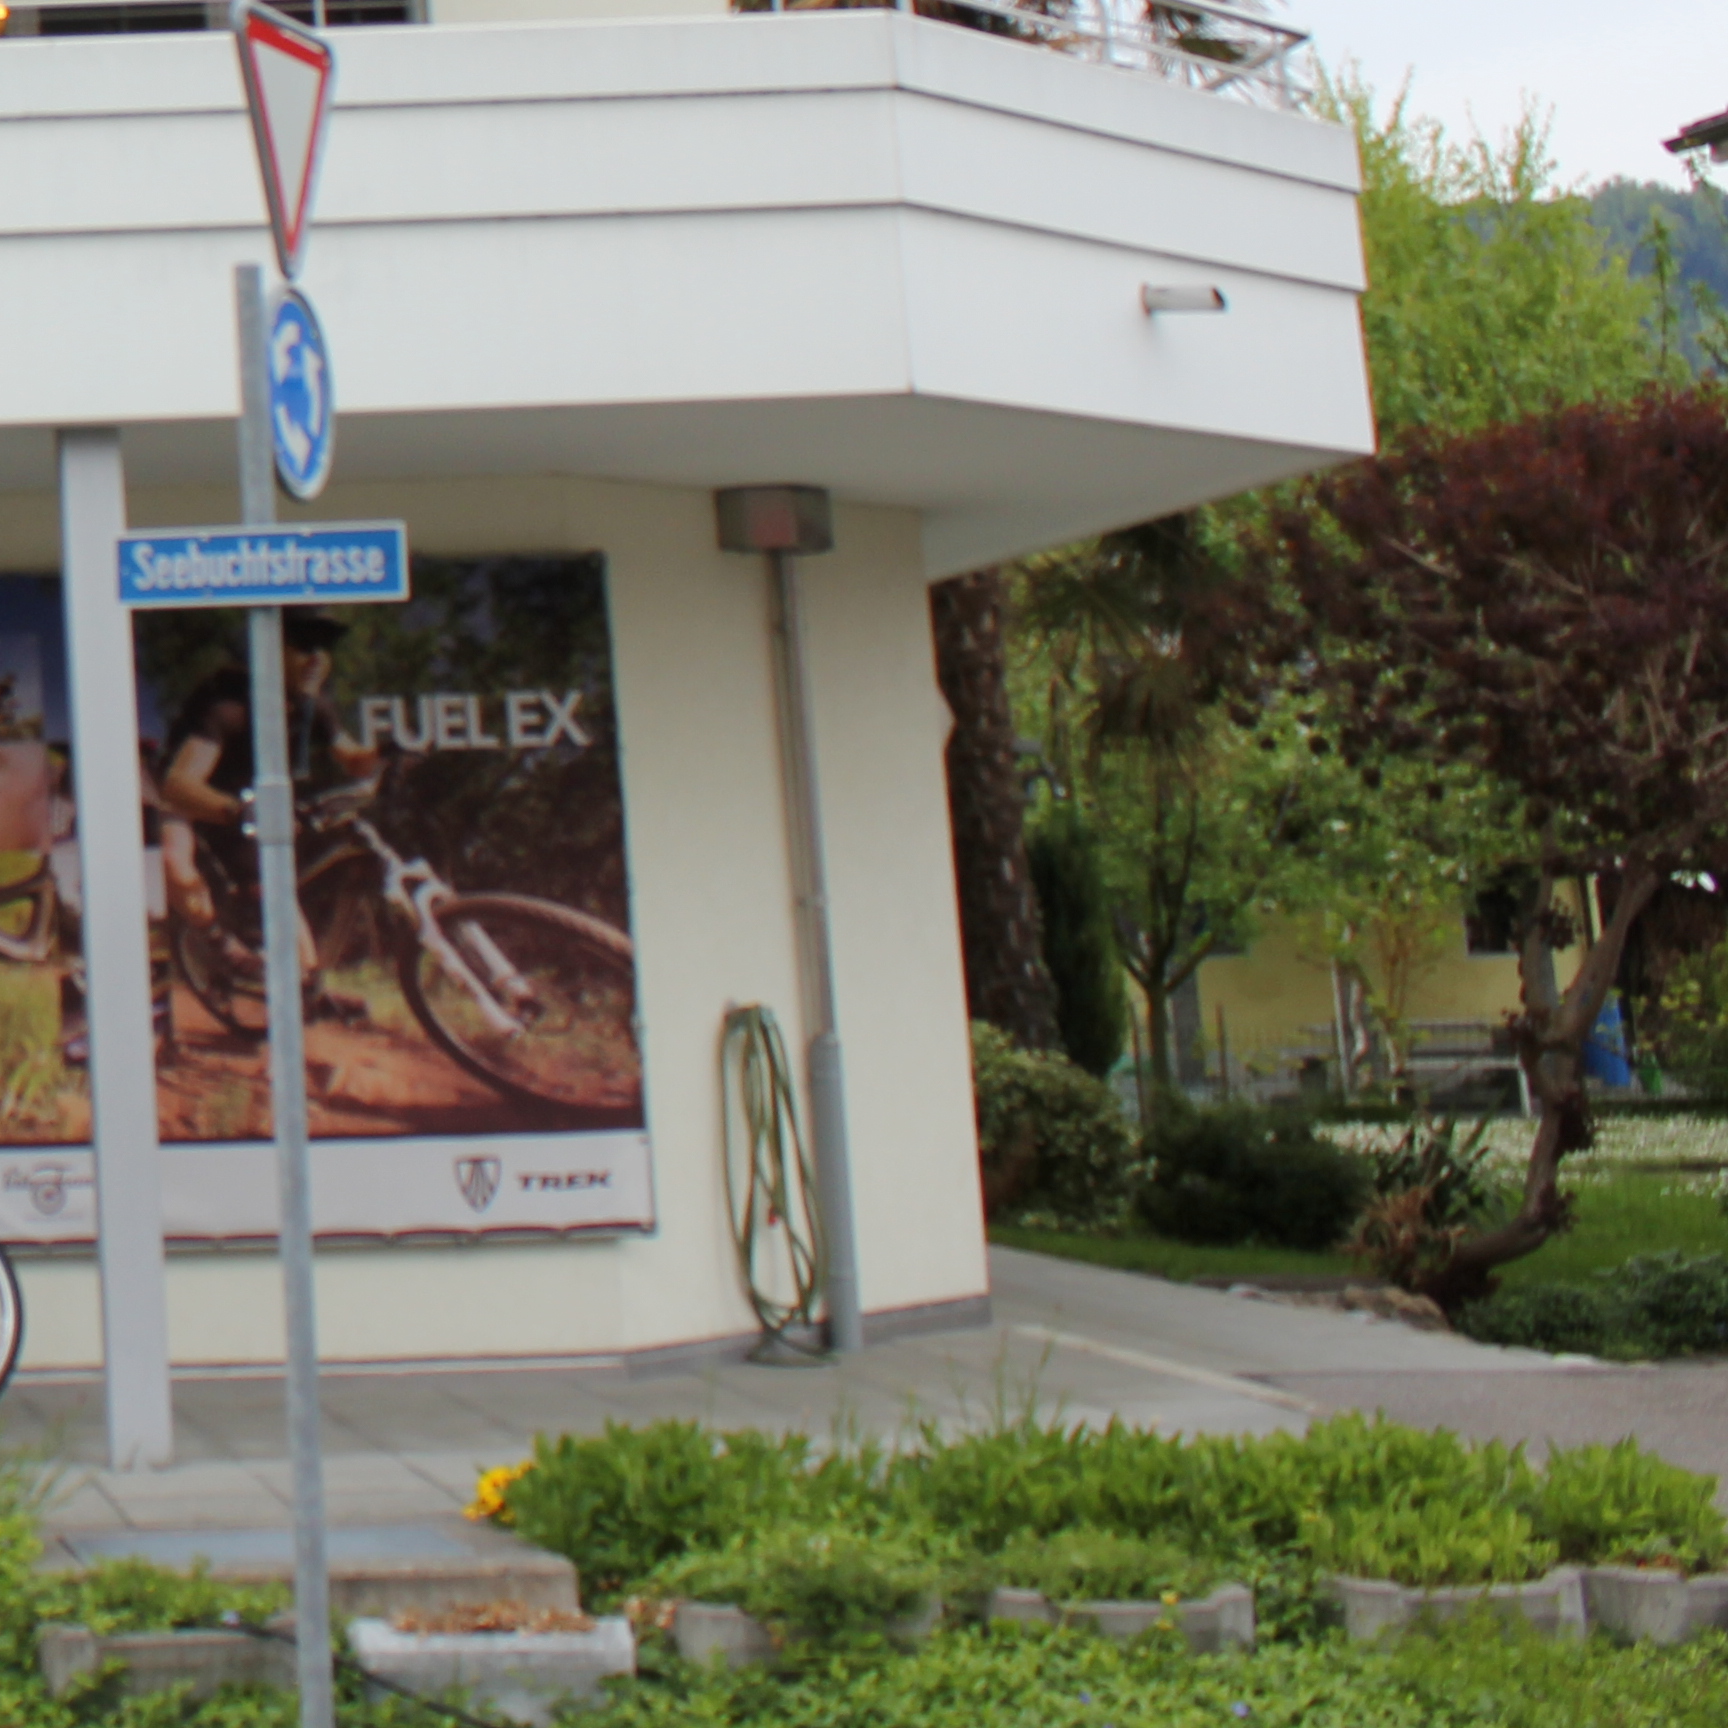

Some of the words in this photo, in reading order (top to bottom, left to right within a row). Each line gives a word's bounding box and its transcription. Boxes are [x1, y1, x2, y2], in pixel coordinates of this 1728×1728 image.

[131, 539, 386, 590] Seebuchtstrasse
[359, 691, 500, 754] FUEL
[505, 687, 594, 747] EX
[518, 1170, 611, 1191] TREK
